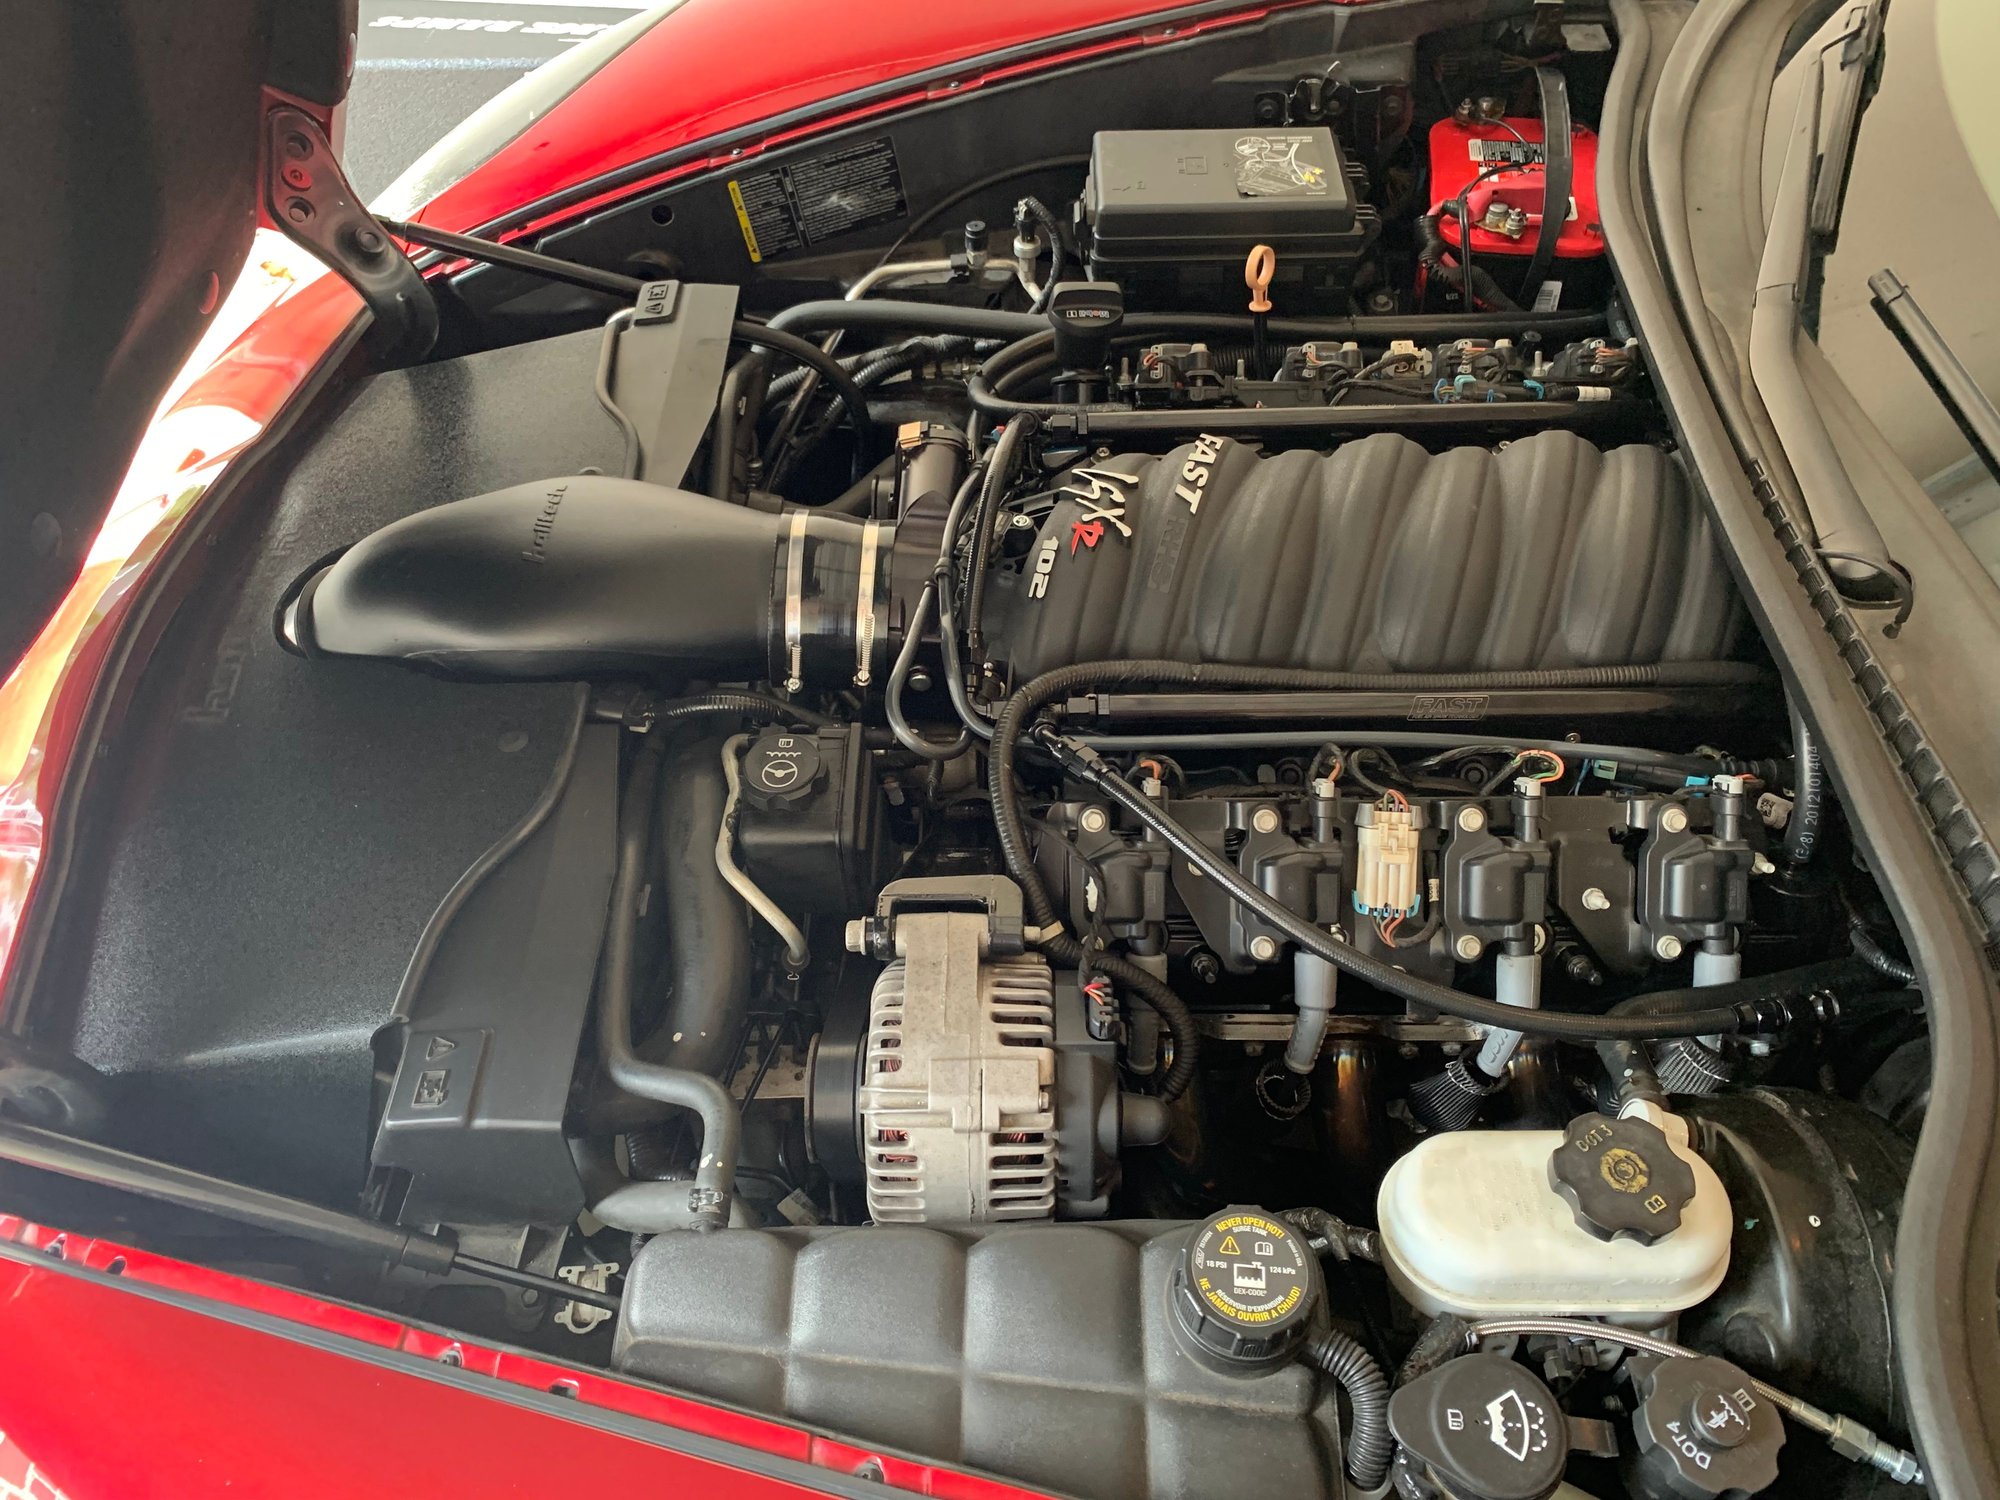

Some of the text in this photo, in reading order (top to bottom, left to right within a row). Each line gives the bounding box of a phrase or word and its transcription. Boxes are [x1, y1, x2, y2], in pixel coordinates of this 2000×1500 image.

[1175, 433, 1224, 515] FAST
[1028, 536, 1059, 599] 102
[1416, 697, 1483, 713] FAST
[1575, 1124, 1613, 1152] DOT 3
[1216, 1217, 1285, 1239] NEVER OPEN HOT!
[1232, 1225, 1268, 1236] SURGE TANK
[1216, 1261, 1227, 1269] PSI
[1269, 1266, 1281, 1274] 124
[1199, 1277, 1211, 1290] NE
[1206, 1291, 1236, 1317] JAMAIS
[1237, 1311, 1270, 1322] OUVRIR
[1277, 1286, 1302, 1314] CHAUD!
